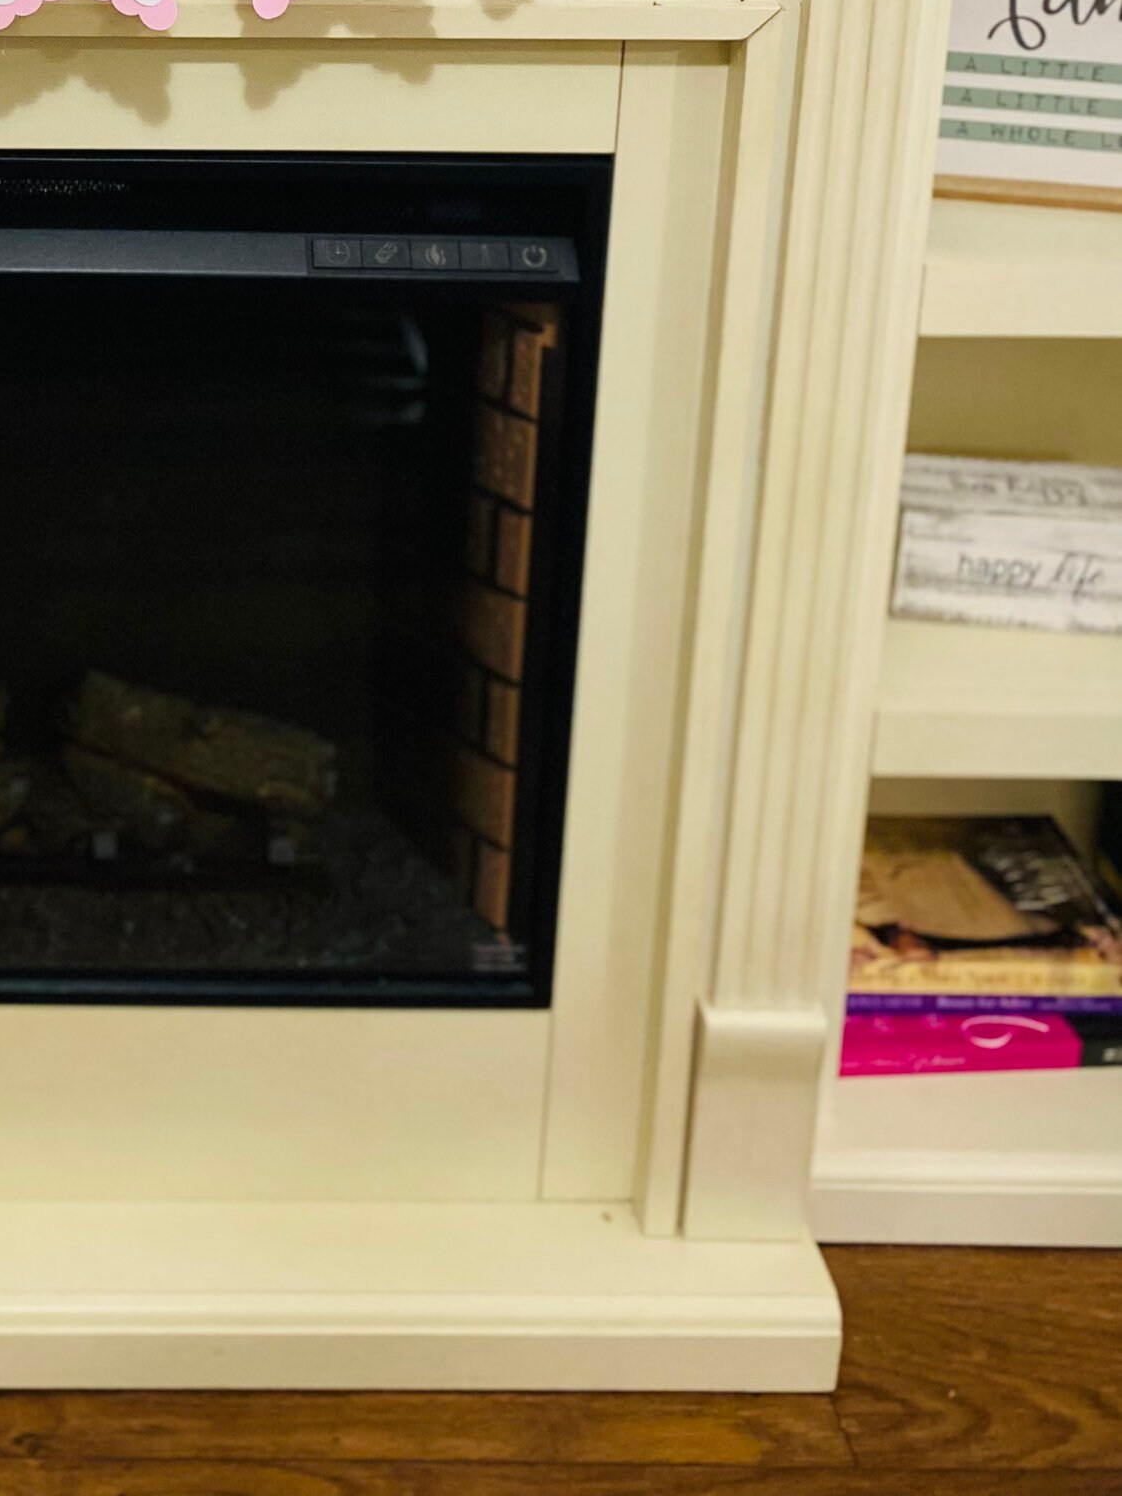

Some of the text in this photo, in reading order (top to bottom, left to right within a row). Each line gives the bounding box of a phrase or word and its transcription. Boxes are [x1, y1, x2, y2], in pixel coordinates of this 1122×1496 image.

[1000, 59, 1105, 82] LITTLE
[996, 91, 1100, 115] LITTLE
[990, 123, 1076, 145] WHOLE
[1101, 134, 1122, 150] L
[957, 554, 1042, 589] happy
